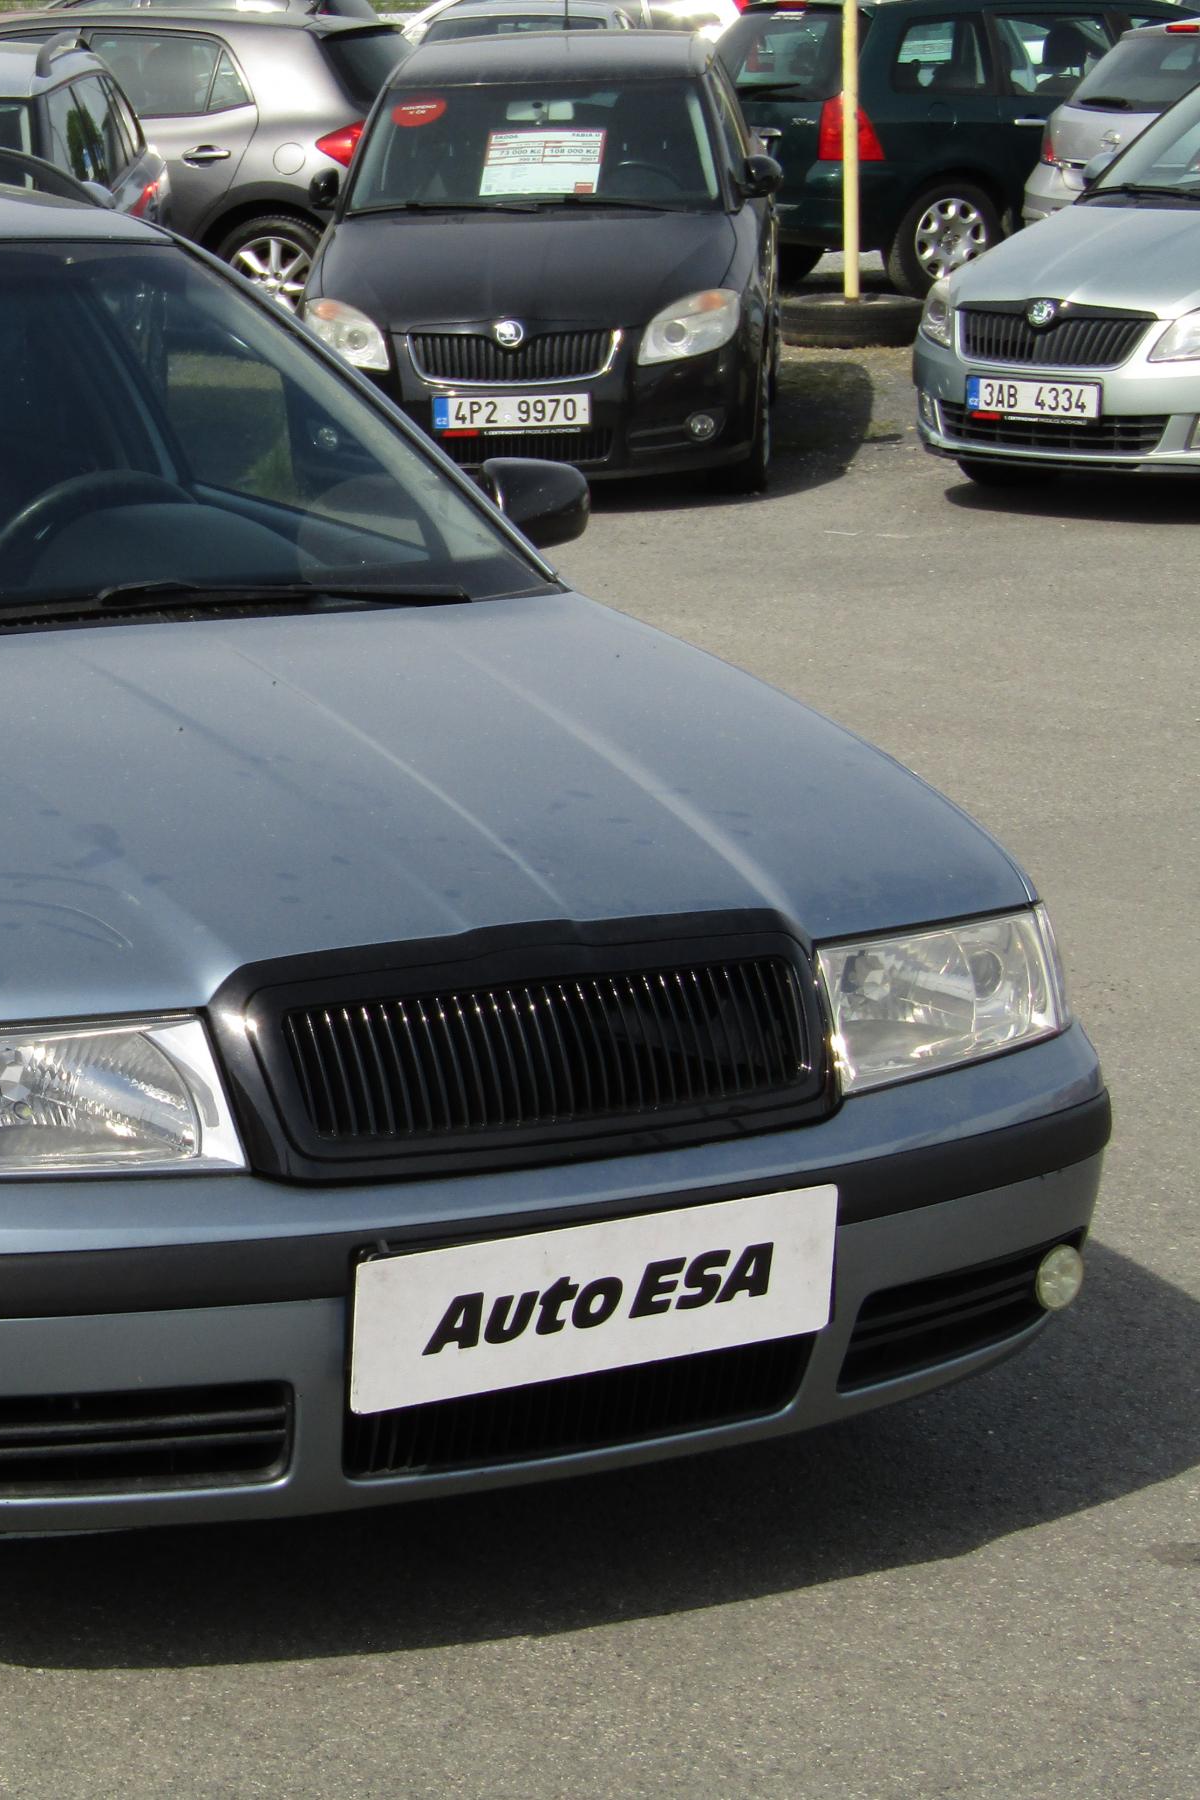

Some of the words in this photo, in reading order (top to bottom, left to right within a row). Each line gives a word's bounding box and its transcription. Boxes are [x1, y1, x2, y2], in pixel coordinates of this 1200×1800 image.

[454, 400, 498, 424] 4P2
[517, 398, 577, 423] 9970
[968, 398, 979, 406] CZ
[984, 383, 1018, 409] 3AB
[1035, 386, 1087, 413] 4334
[422, 1275, 624, 1356] Auto
[628, 1242, 775, 1320] ESA
